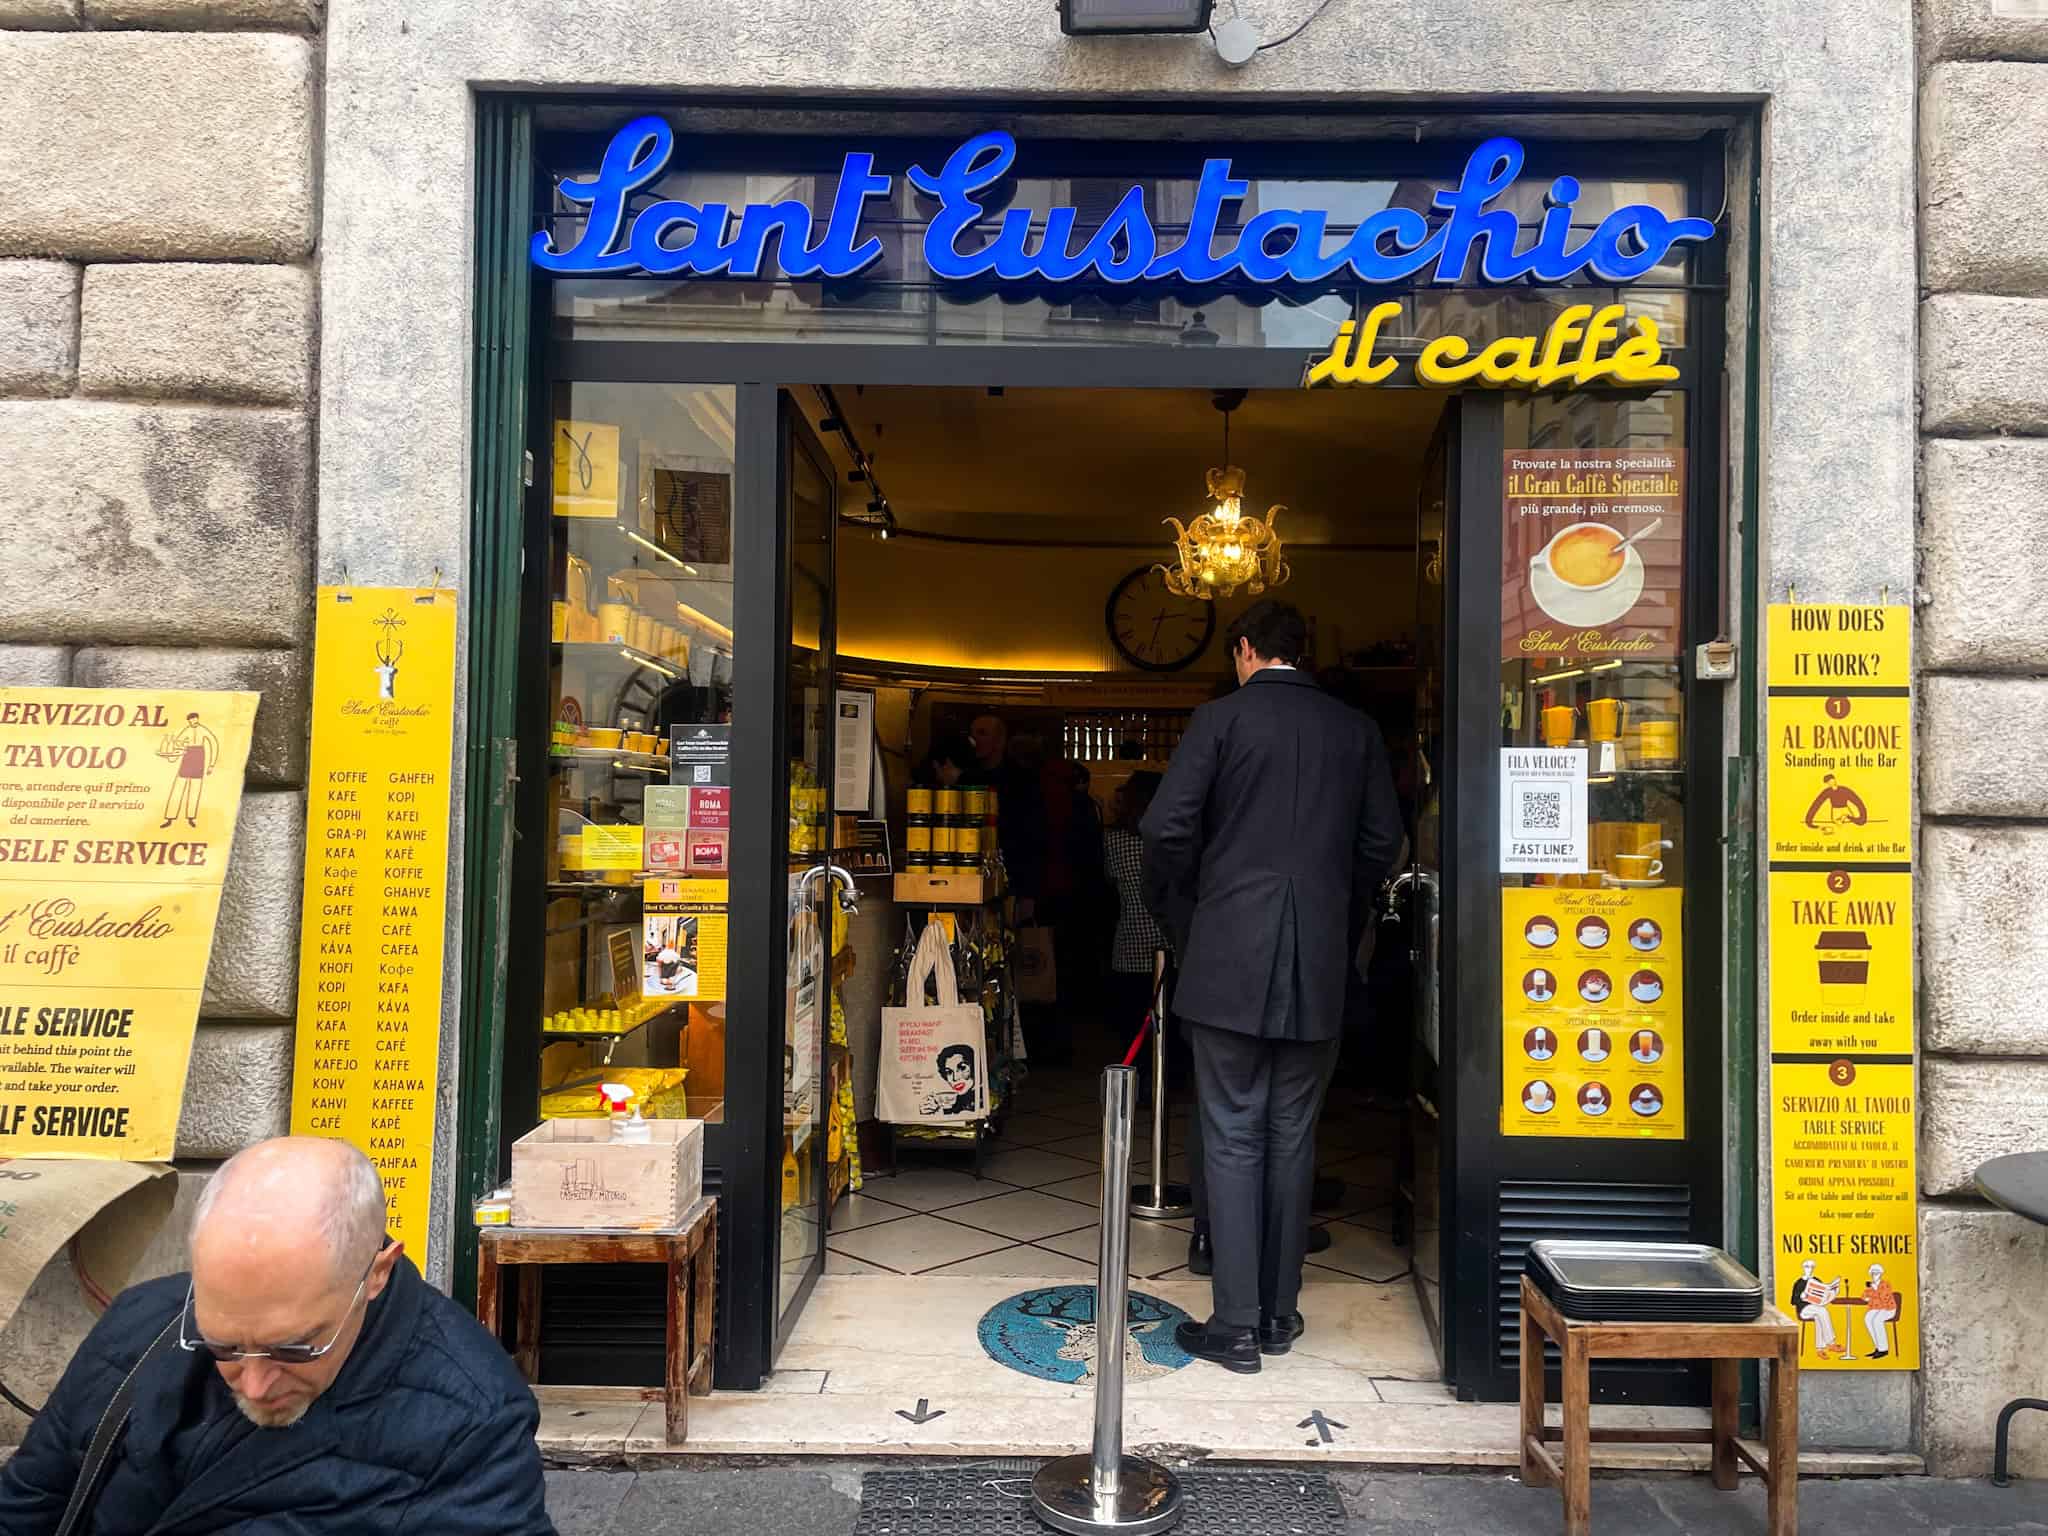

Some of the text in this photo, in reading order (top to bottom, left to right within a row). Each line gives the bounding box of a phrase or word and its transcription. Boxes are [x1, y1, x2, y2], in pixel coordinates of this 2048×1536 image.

[531, 115, 1715, 283] Sant Eustachio
[1305, 302, 1680, 390] il caffè
[1512, 458, 1676, 471] Provate la nostra Specialità:
[1508, 473, 1679, 496] il Gran Caffè Speciale
[1520, 503, 1665, 515] più grande, più cremoso.
[1791, 609, 1884, 631] HOW DOES
[1795, 653, 1881, 676] IT WORK?
[1833, 700, 1841, 714] 1
[0, 702, 168, 728] ERVIZIO AL
[1783, 725, 1903, 750] AL BANCONE
[5, 744, 127, 769] TAVOLO
[1508, 755, 1576, 768] FILA VELOCE?
[1785, 752, 1897, 770] Standing at the Bar
[329, 771, 368, 783] KOFFIE
[389, 772, 435, 785] GAHFEH
[26, 781, 151, 795] attendere qui il primo
[328, 790, 357, 802] KAFE
[388, 791, 415, 803] KOPI
[1, 797, 145, 811] disponibile per il servizio
[10, 814, 91, 826] del cameriere.
[327, 809, 361, 821] KOPHI
[386, 810, 419, 822] KAFEI
[326, 828, 366, 840] GRA-PI
[386, 829, 428, 841] KAWHE
[0, 838, 208, 867] SELF SERVICE
[325, 847, 356, 859] KAFA
[1512, 844, 1574, 855] FAST LINE?
[1776, 842, 1906, 853] Order inside and drink at the Bar
[384, 867, 424, 879] KOFFIE
[1834, 876, 1844, 888] 2
[383, 886, 431, 898] GHAHVE
[322, 904, 353, 916] GAFE
[382, 905, 418, 917] KAWA
[1792, 900, 1897, 925] TAKE AWAY
[321, 921, 352, 935] CAFÉ
[382, 922, 413, 936] CAFÉ
[380, 943, 419, 956] CAFEA
[4, 943, 80, 975] il caffè
[319, 962, 353, 974] KHOFI
[318, 981, 346, 993] KOPI
[378, 982, 410, 994] KAFA
[317, 1001, 351, 1013] KEOPI
[0, 1006, 134, 1038] LE SERVICE
[1791, 1011, 1895, 1024] Order inside and take
[316, 1020, 347, 1032] KAFA
[376, 1021, 409, 1033] KAVA
[314, 1039, 351, 1051] KAFFE
[375, 1038, 407, 1051] CAFÉ
[1809, 1035, 1877, 1048] away with you
[13, 1043, 133, 1058] behind this point the
[50, 1062, 136, 1075] The waiter will
[313, 1058, 359, 1071] KAFEJO
[374, 1060, 411, 1071] KAFFE
[1837, 1066, 1848, 1079] 3
[4, 1080, 119, 1095] and take your order.
[312, 1078, 345, 1090] KOHV
[373, 1079, 425, 1091] KAHAWA
[311, 1098, 347, 1109] KAHVI
[372, 1098, 414, 1110] KAFFEE
[1782, 1096, 1911, 1113] SERVIZIO AL TAVOLO
[31, 1105, 130, 1138] SERVICE
[1803, 1120, 1885, 1135] TABLE SERVICE
[370, 1137, 405, 1149] KAAPI
[1797, 1193, 1804, 1201] at
[1807, 1192, 1818, 1201] the
[1821, 1192, 1838, 1201] table
[1841, 1192, 1854, 1201] and
[1856, 1192, 1868, 1201] the
[1871, 1192, 1893, 1201] waiter
[1895, 1192, 1909, 1201] will
[1819, 1209, 1875, 1220] take your order
[1783, 1234, 1913, 1255] NO SELF SERVICE
